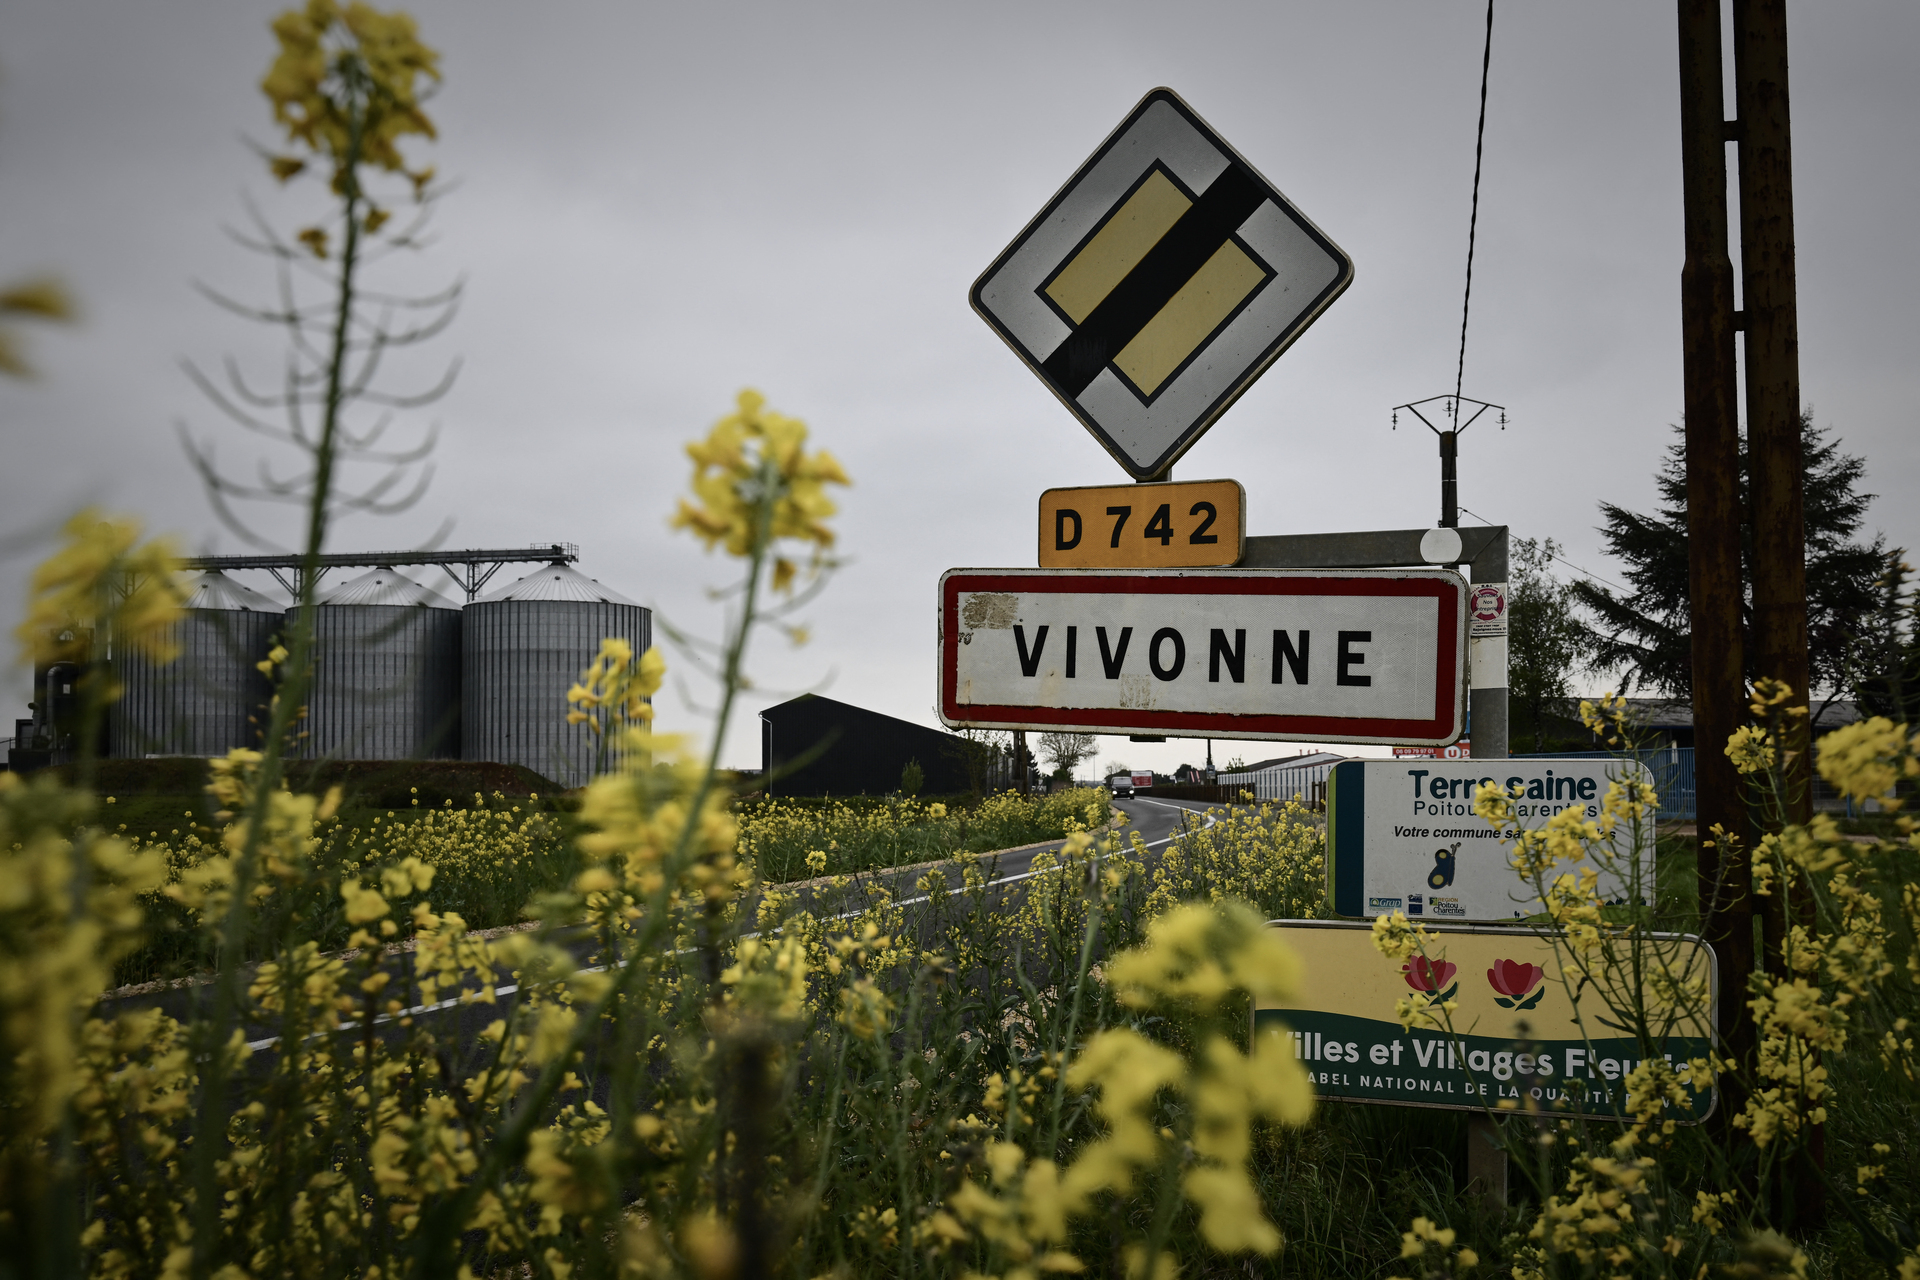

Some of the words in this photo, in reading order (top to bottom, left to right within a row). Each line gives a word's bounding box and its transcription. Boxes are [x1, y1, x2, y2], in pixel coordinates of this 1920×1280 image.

[1055, 508, 1083, 551] D
[1106, 501, 1219, 549] 742
[1012, 624, 1372, 687] VIVONNE
[1506, 769, 1597, 801] saine
[1394, 825, 1429, 839] Votre
[1433, 828, 1501, 839] commune
[1369, 1039, 1404, 1066] et
[1411, 1038, 1554, 1081] Villages
[1298, 1071, 1350, 1086] ABEL
[1360, 1075, 1455, 1093] NATIONAL
[1465, 1082, 1488, 1096] DE
[1498, 1084, 1520, 1098] LA
